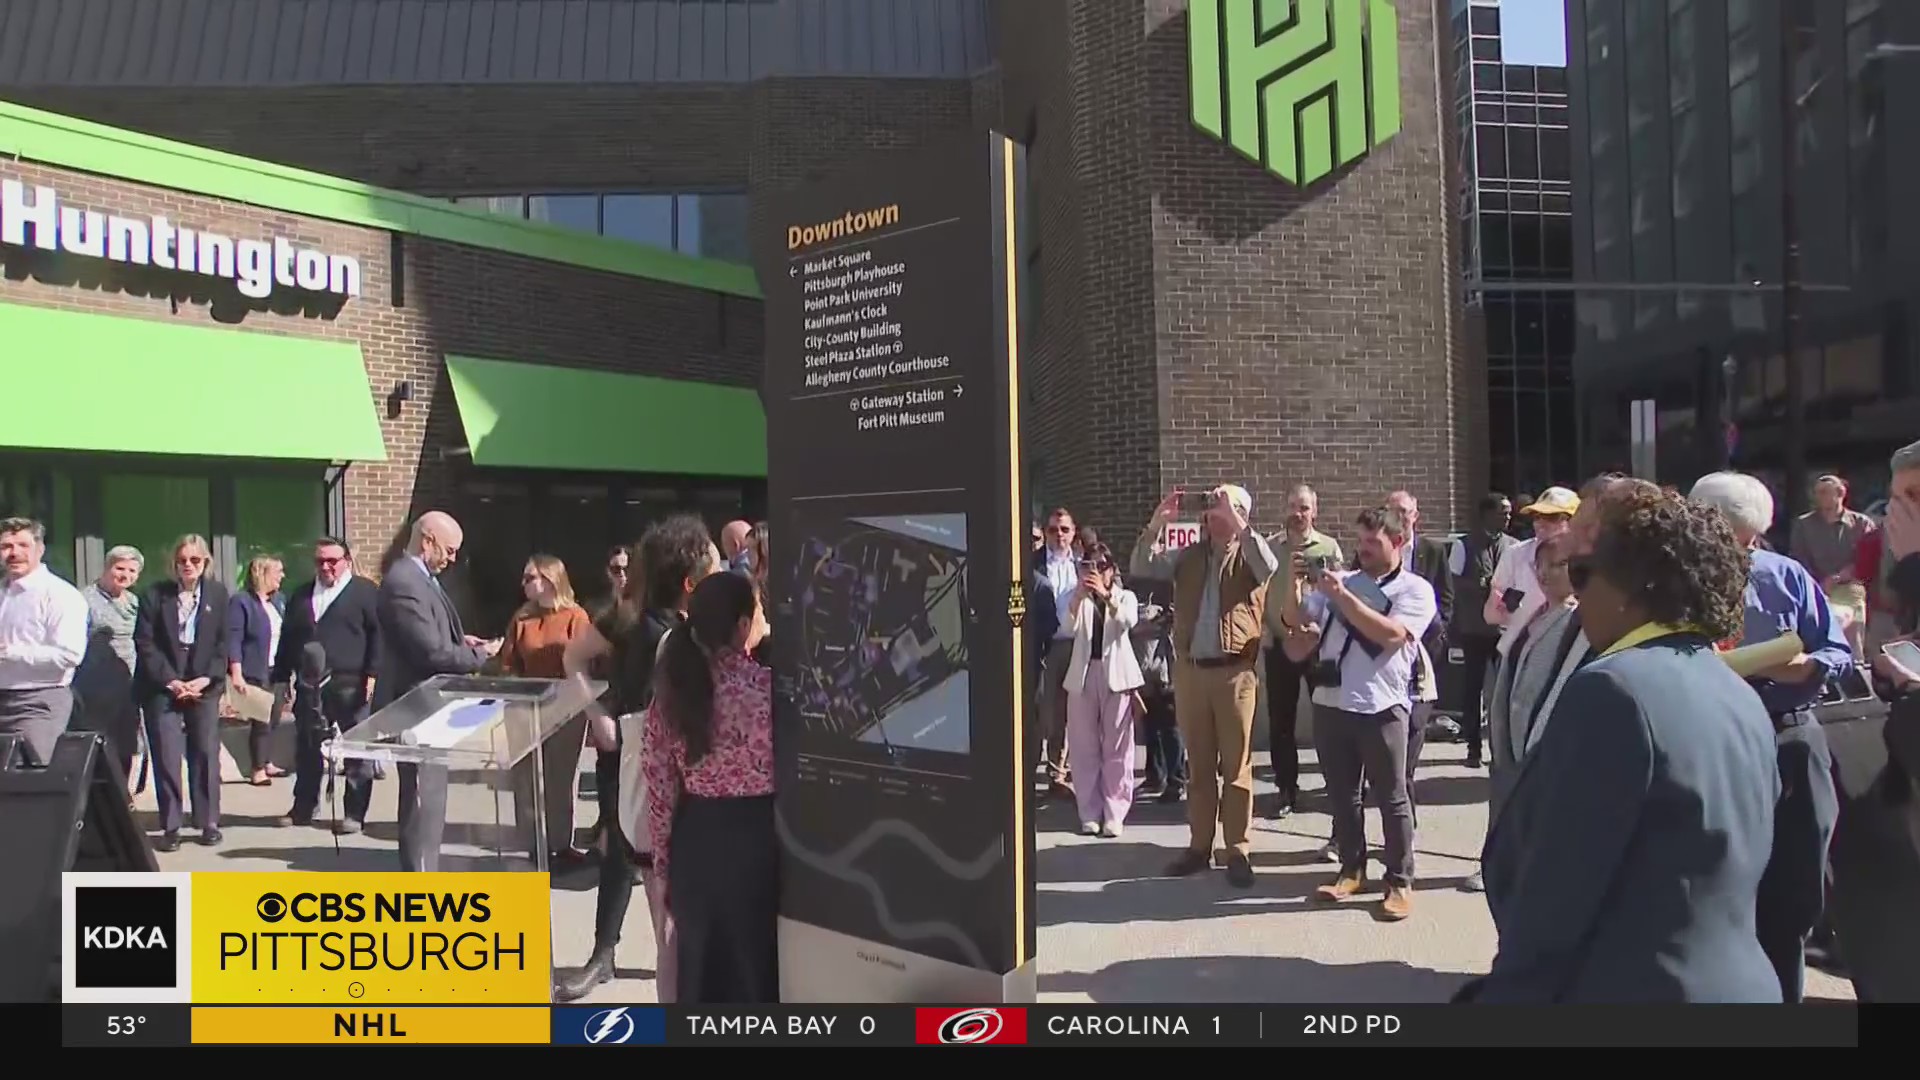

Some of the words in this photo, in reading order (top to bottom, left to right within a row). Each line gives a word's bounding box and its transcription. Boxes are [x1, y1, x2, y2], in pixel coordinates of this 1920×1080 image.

[1, 178, 362, 299] Huntington
[788, 203, 900, 249] Downtown
[804, 258, 837, 274] Market
[838, 250, 871, 268] Square
[804, 272, 853, 293] Pittsburgh
[855, 261, 905, 284] Playhouse
[805, 295, 828, 311] Point
[829, 292, 850, 306] Park
[852, 281, 903, 302] University
[805, 310, 860, 330] Kaufmann's
[861, 304, 888, 320] Clock
[805, 328, 859, 350] City-County
[861, 321, 901, 338] Building
[805, 353, 828, 368] Steel
[829, 349, 854, 365] Plaza
[856, 343, 891, 360] Station
[805, 368, 851, 388] Allegheny
[853, 362, 888, 380] County
[889, 354, 949, 374] Courthouse
[862, 392, 904, 410] Gateway
[906, 388, 944, 405] Station
[858, 416, 878, 431] Fort
[879, 412, 899, 428] Pitt
[899, 410, 944, 427] Museum
[1168, 528, 1196, 548] FDC
